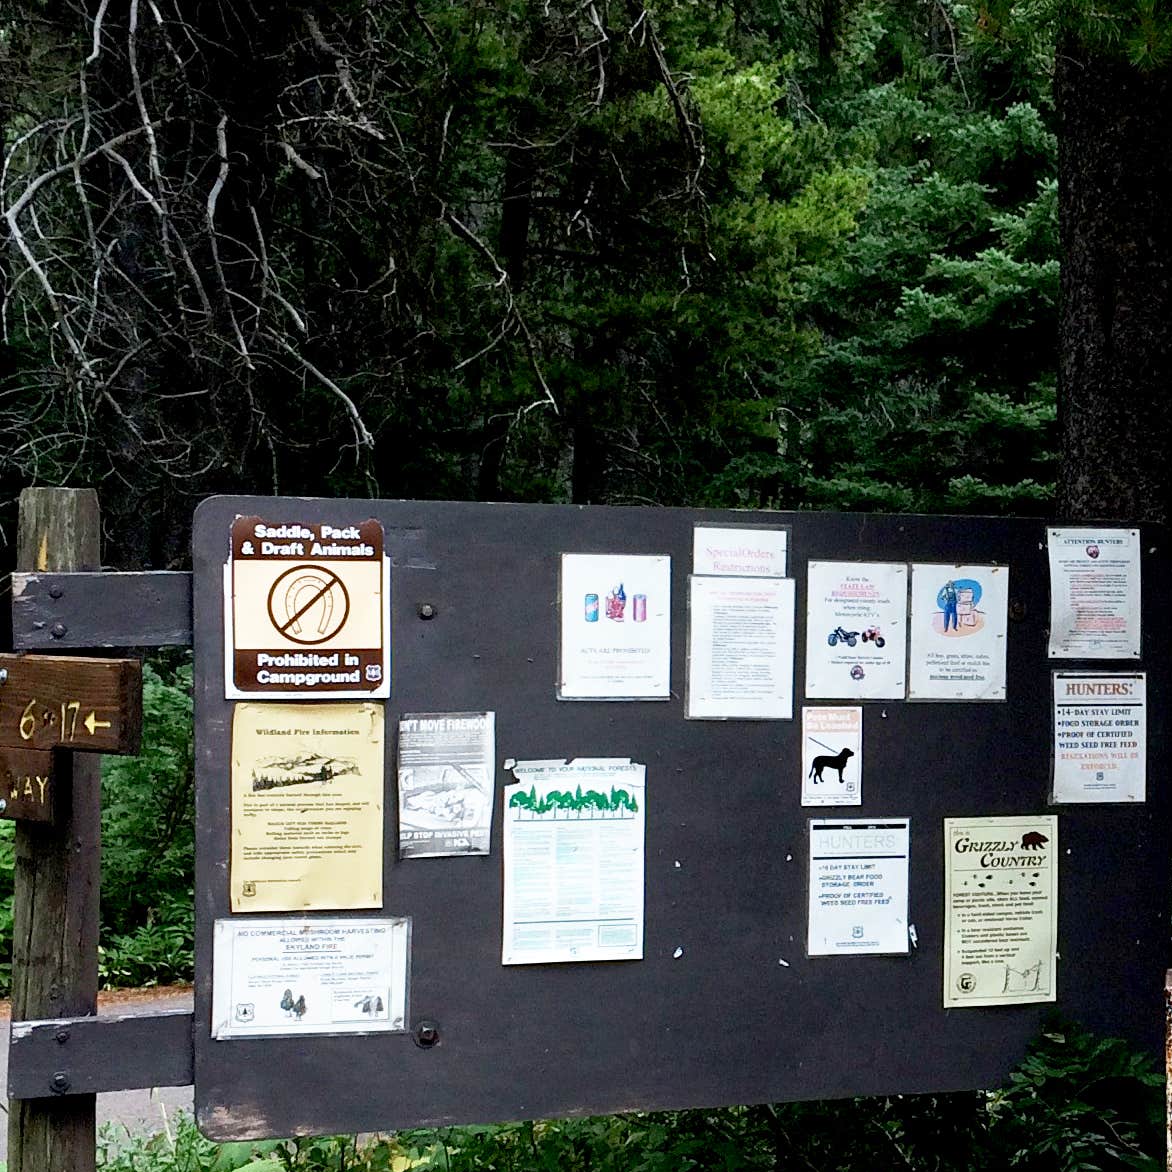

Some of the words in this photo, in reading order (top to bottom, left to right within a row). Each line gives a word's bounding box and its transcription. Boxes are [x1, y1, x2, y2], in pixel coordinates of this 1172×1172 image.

[255, 525, 315, 540] Saddle,
[321, 526, 360, 539] Pack
[241, 542, 254, 555] &
[262, 542, 304, 555] Draft
[311, 543, 373, 556] Animals
[257, 654, 338, 666] Prohibited
[345, 654, 359, 666] in
[257, 670, 360, 685] Campground
[1066, 683, 1133, 695] HUNTERS:
[20, 700, 36, 740] 6
[61, 702, 80, 742] 17
[955, 838, 1019, 852] GRIZZLY
[980, 853, 1047, 868] COUNTRY
